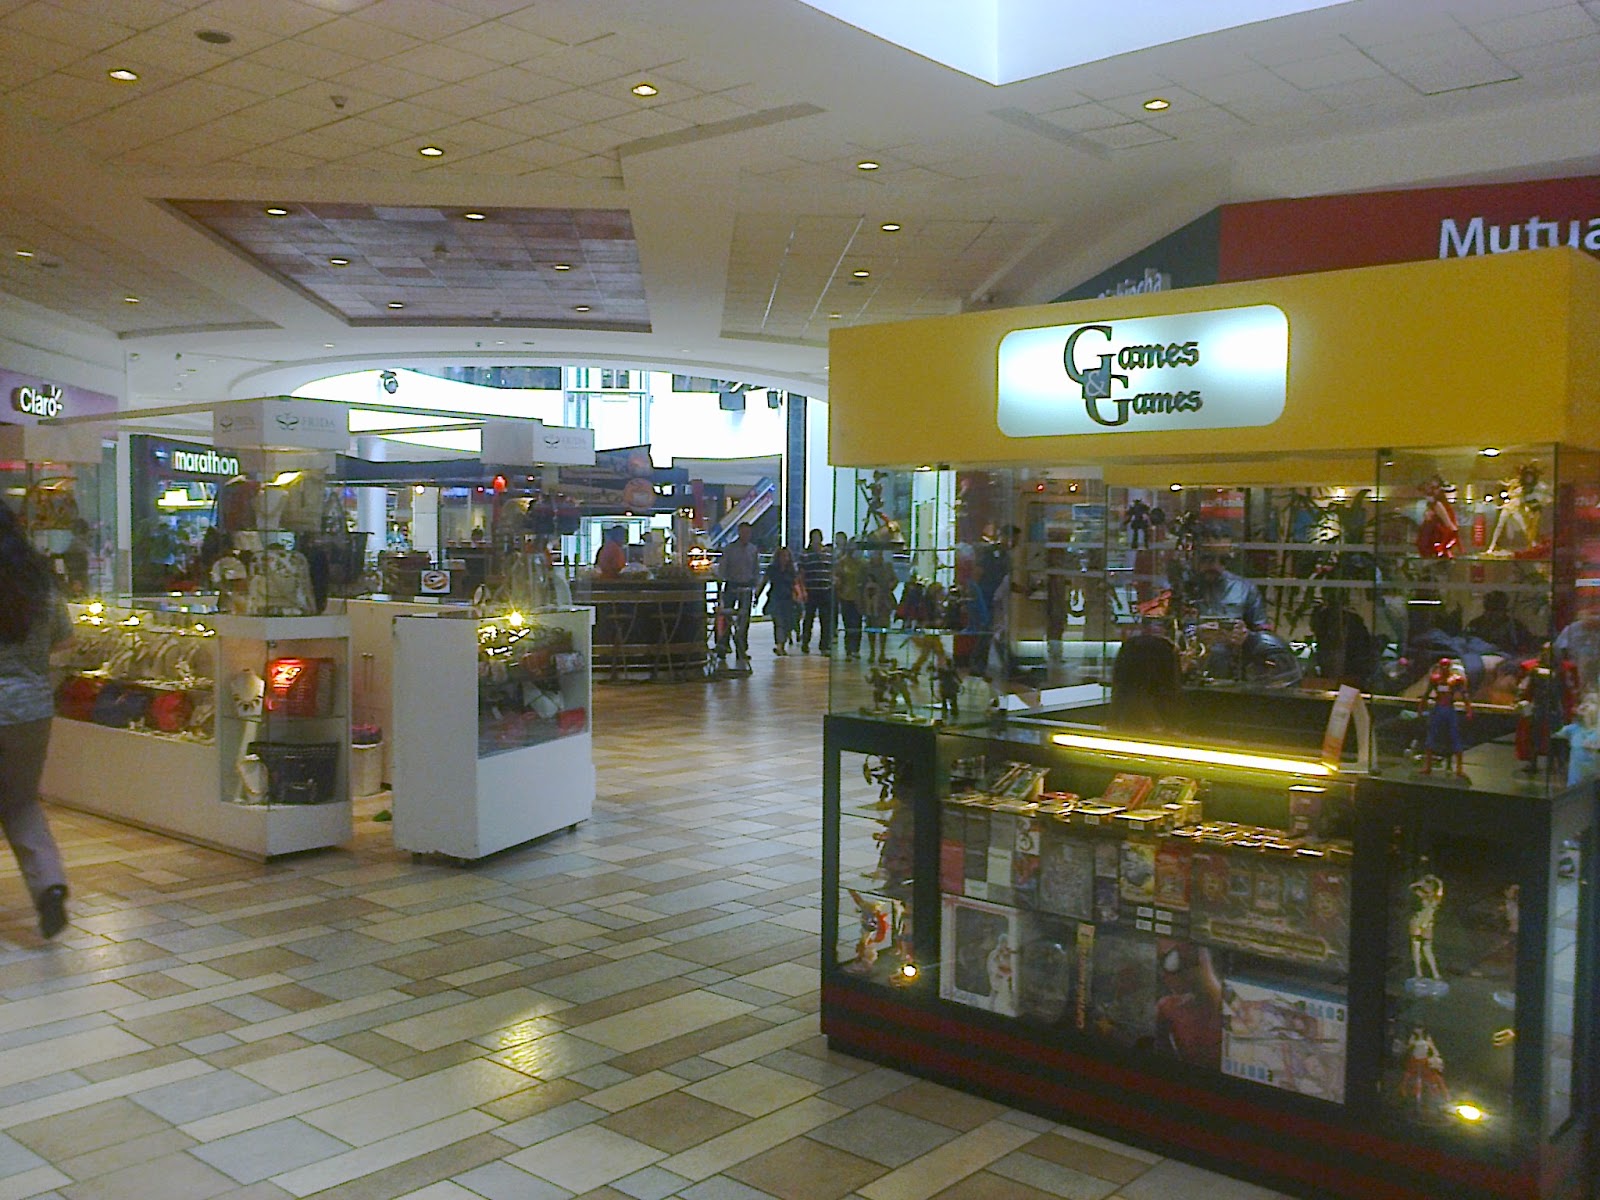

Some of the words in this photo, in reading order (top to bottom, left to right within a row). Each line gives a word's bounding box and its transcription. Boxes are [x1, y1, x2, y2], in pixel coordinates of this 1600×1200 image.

[1063, 325, 1200, 383] Games
[1084, 370, 1108, 397] &
[20, 386, 59, 417] Claro
[1084, 374, 1204, 427] Games
[173, 450, 239, 476] marathon
